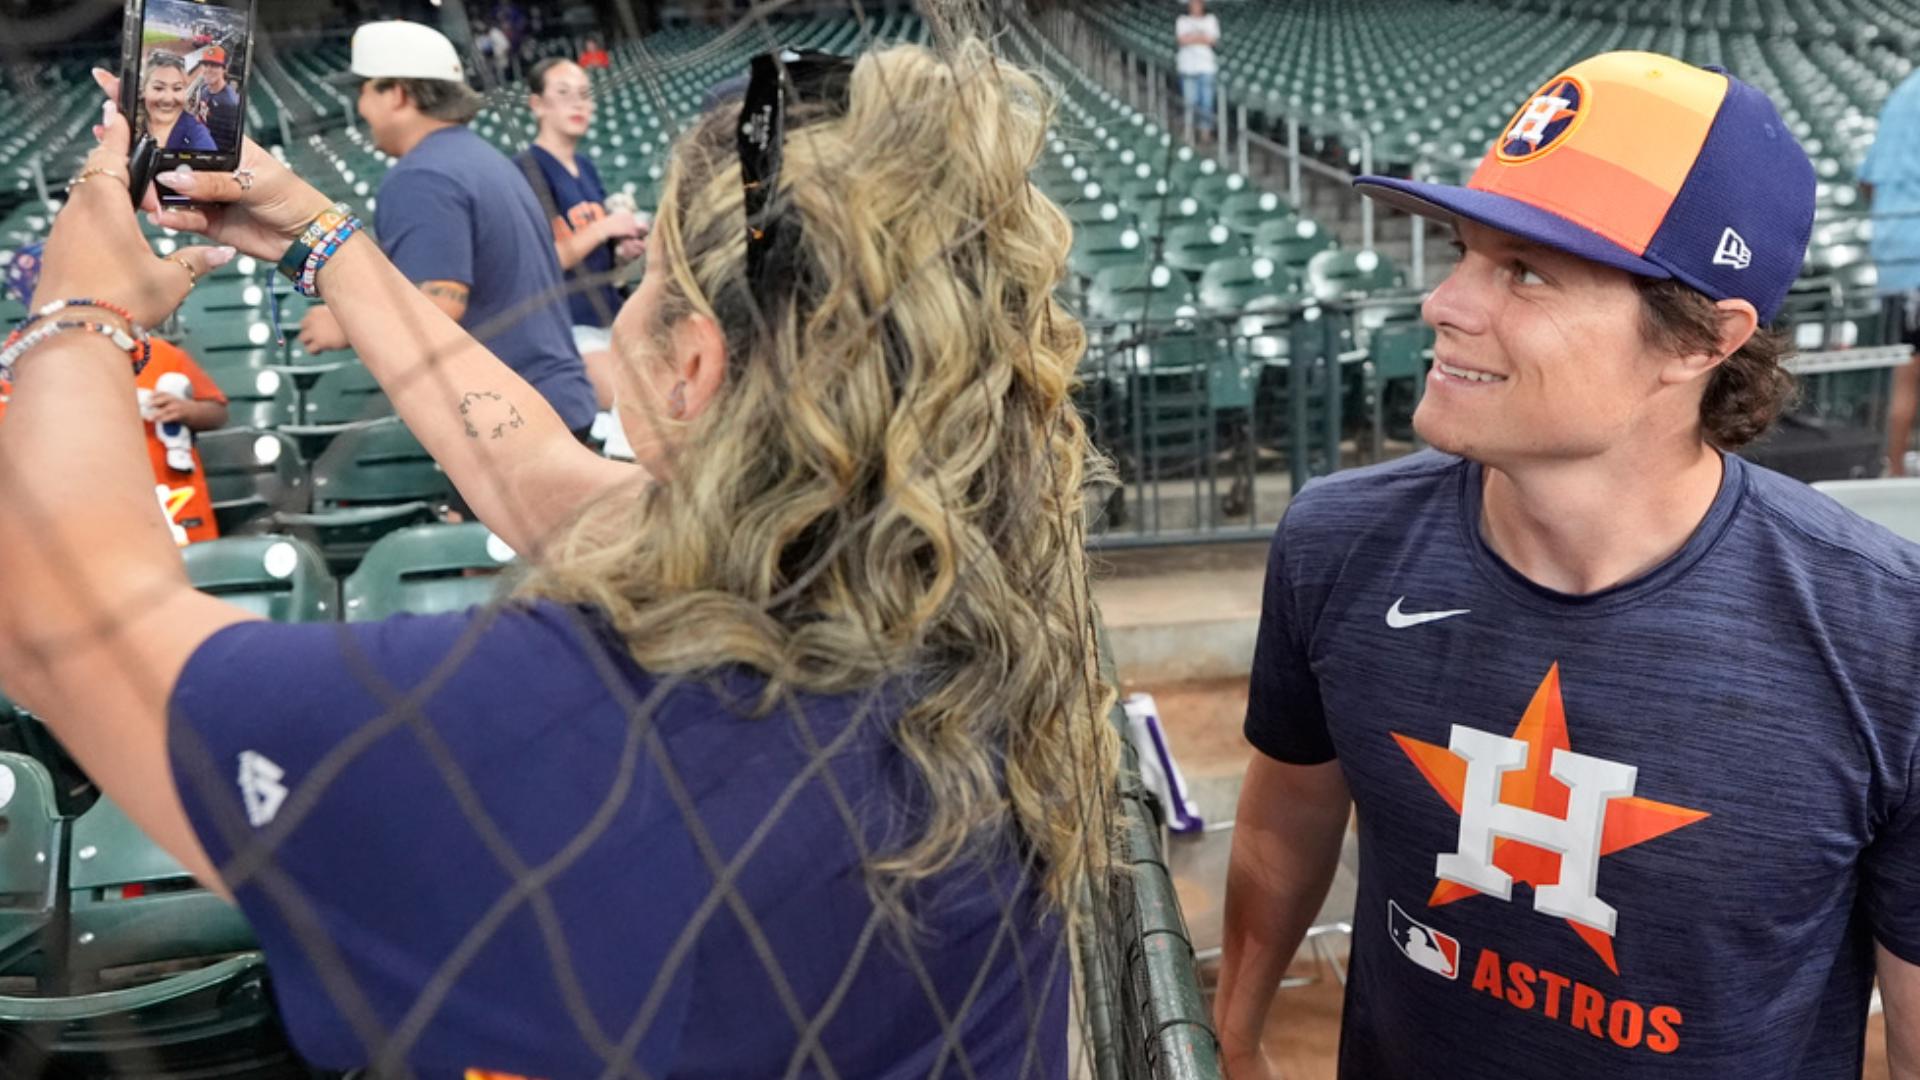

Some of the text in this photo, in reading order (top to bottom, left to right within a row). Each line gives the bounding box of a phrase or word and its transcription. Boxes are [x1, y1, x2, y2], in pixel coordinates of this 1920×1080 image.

[1507, 95, 1571, 145] H
[1435, 723, 1638, 937] H
[1472, 948, 1683, 1054] ASTROS
